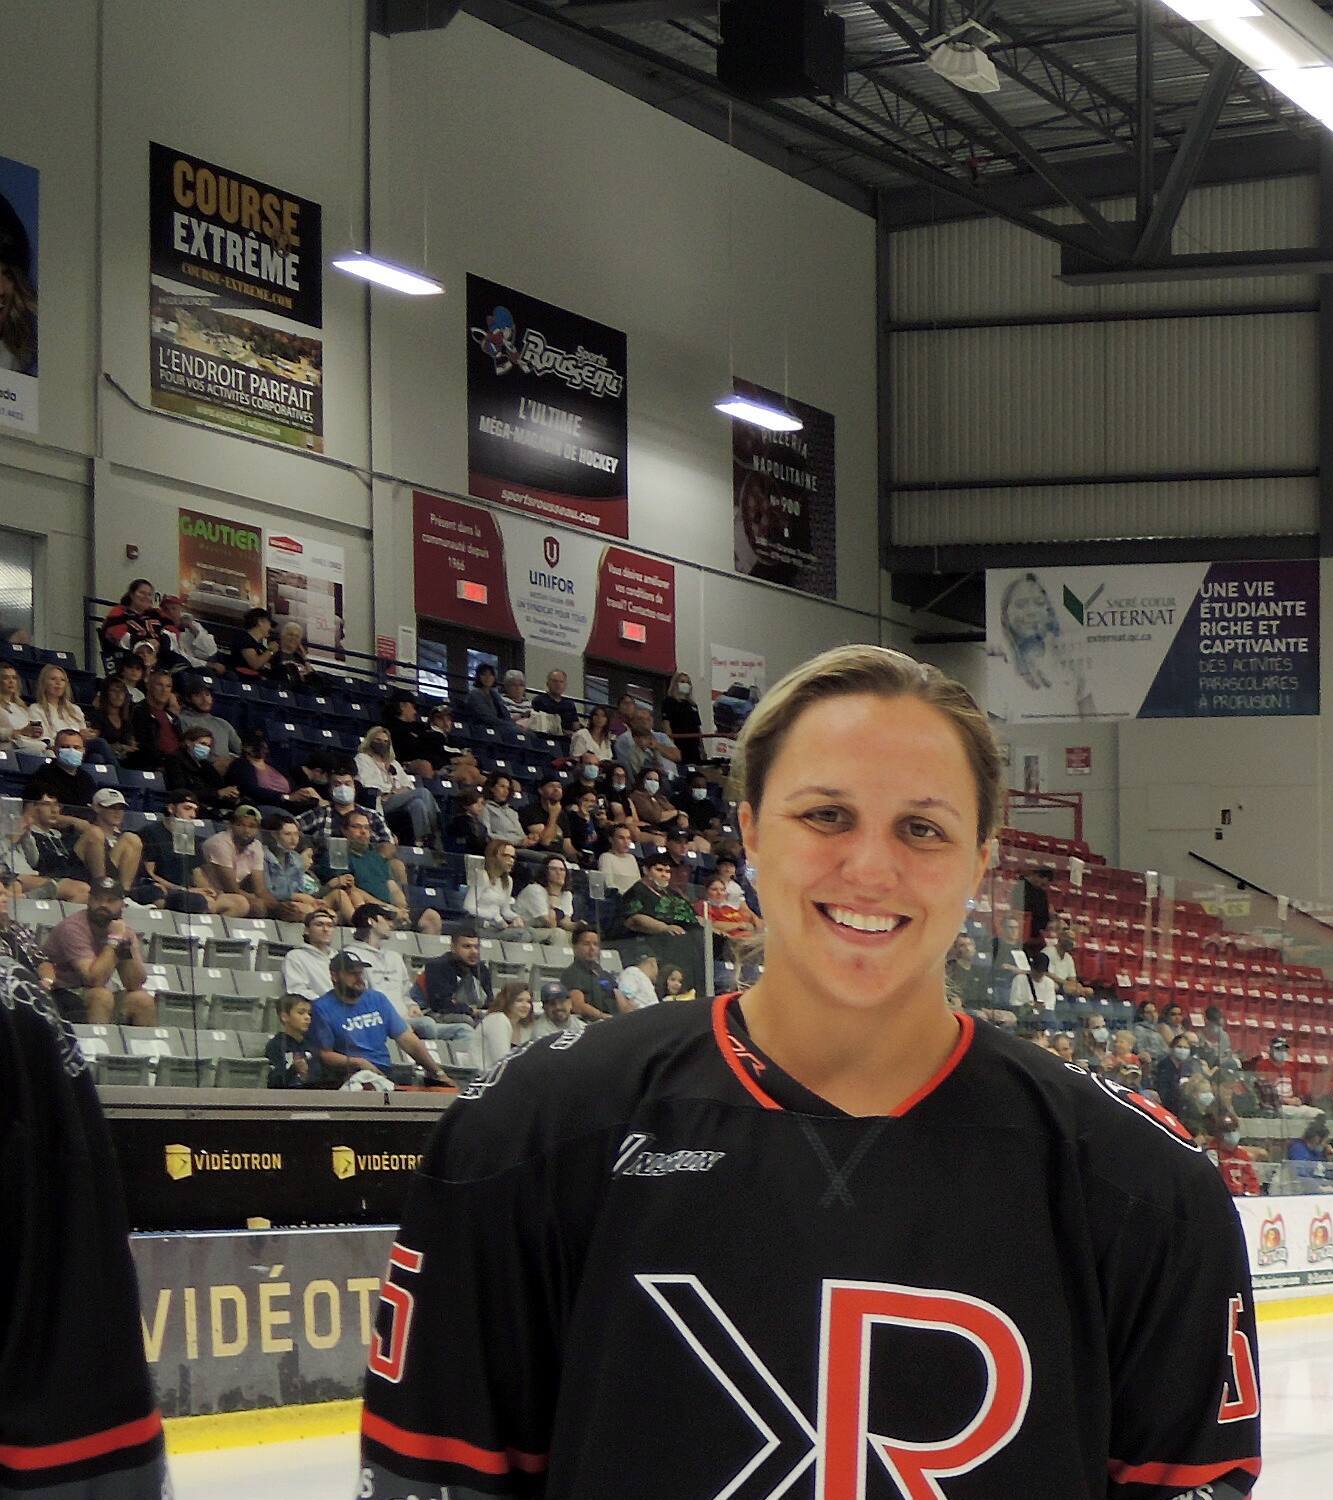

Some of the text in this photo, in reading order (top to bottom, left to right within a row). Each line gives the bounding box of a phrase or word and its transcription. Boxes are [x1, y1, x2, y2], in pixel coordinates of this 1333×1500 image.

[173, 160, 301, 247] COURSE
[173, 211, 300, 291] EXTRÊME
[159, 347, 247, 390] L'ENDROIT
[250, 374, 313, 411] PARFAIT
[160, 369, 185, 386] POUR
[186, 376, 204, 391] VOS
[207, 384, 250, 405] ACTIVITÉS
[252, 396, 313, 424] CORPORATIVES
[518, 397, 583, 437] L'ULTIME
[563, 443, 578, 461] DE
[579, 447, 619, 474] HOCKEY
[752, 454, 817, 492] NAPOLITAINE
[179, 516, 260, 550] GAUTIER
[529, 569, 575, 595] UNIFOR
[1200, 581, 1275, 598] UNE VIE
[1087, 609, 1176, 628] EXTERNAT
[1200, 599, 1307, 618] ÉTUDIANTE
[1200, 620, 1281, 636] RICHE ET
[1200, 638, 1309, 654] CAPTIVANTE
[194, 1149, 282, 1170] VIDÉOTRON
